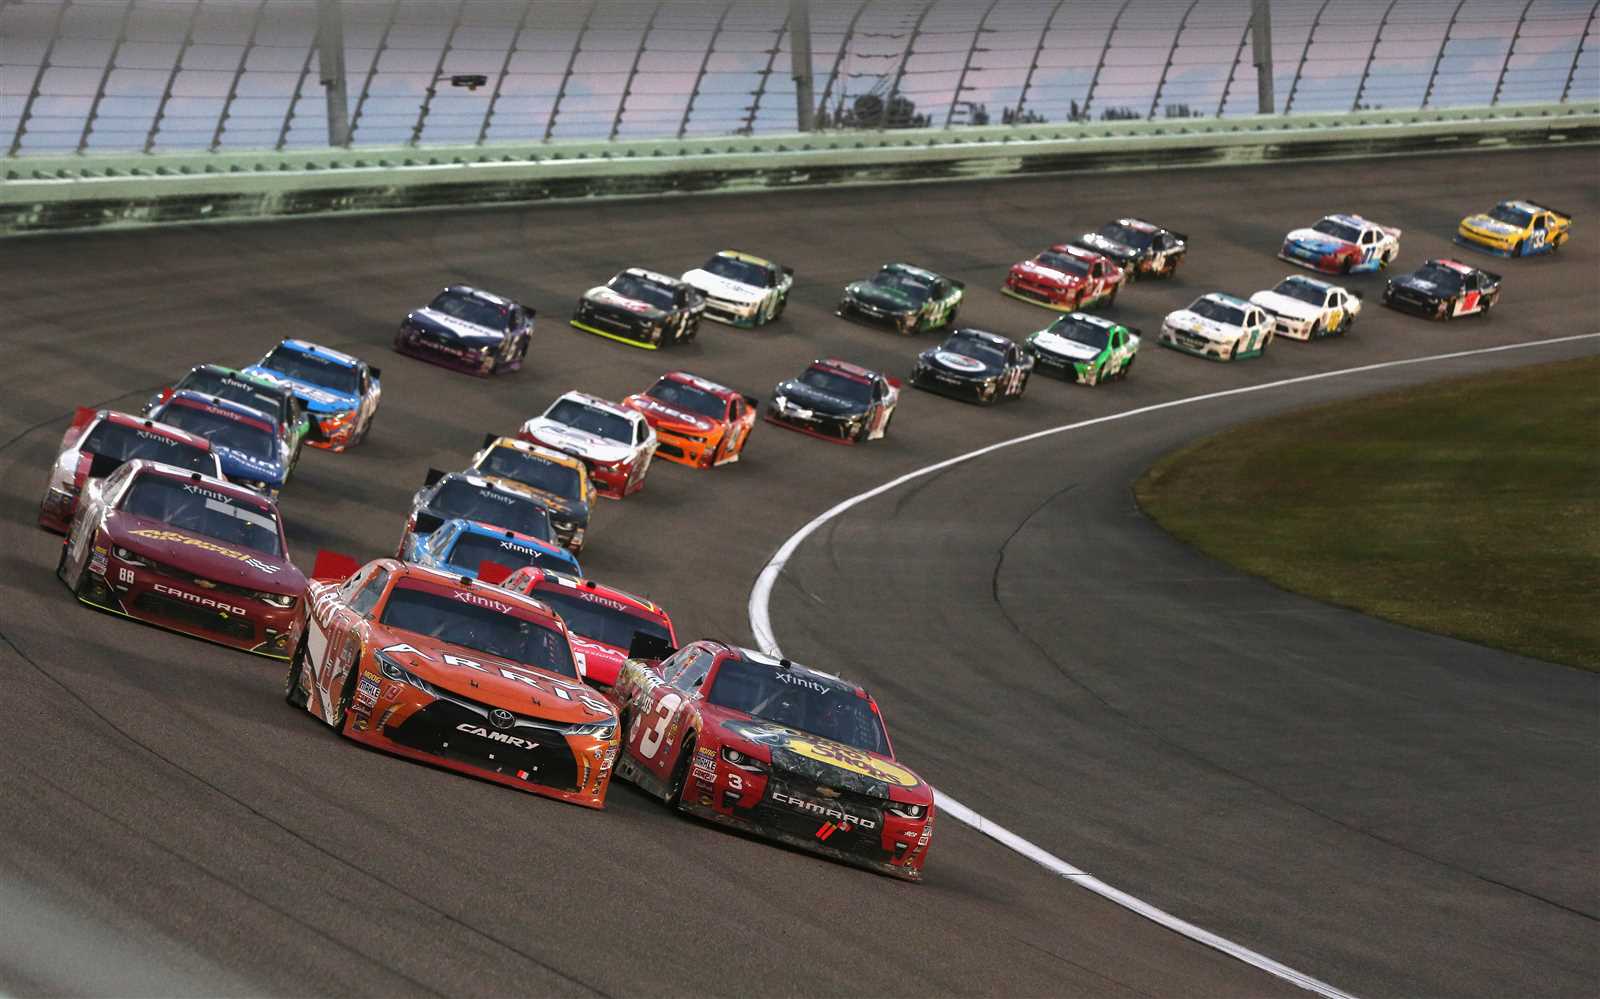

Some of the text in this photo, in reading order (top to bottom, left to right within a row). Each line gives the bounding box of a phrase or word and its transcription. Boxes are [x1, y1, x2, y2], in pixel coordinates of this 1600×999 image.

[220, 376, 254, 393] xfinity
[206, 404, 242, 421] xfinity
[136, 429, 180, 448] xfinity
[183, 483, 233, 504] xfinity
[479, 489, 517, 506] xfinity
[499, 539, 543, 559] xfinity
[119, 567, 135, 585] 88
[152, 582, 247, 617] CAMARO
[453, 590, 513, 614] xfinity
[579, 591, 628, 611] xfinity
[382, 643, 618, 717] ARRIS
[775, 671, 831, 696] xfinity
[640, 693, 682, 759] 3
[455, 723, 541, 751] CAMRY
[727, 773, 743, 790] 3
[772, 791, 876, 830] CAMARO
